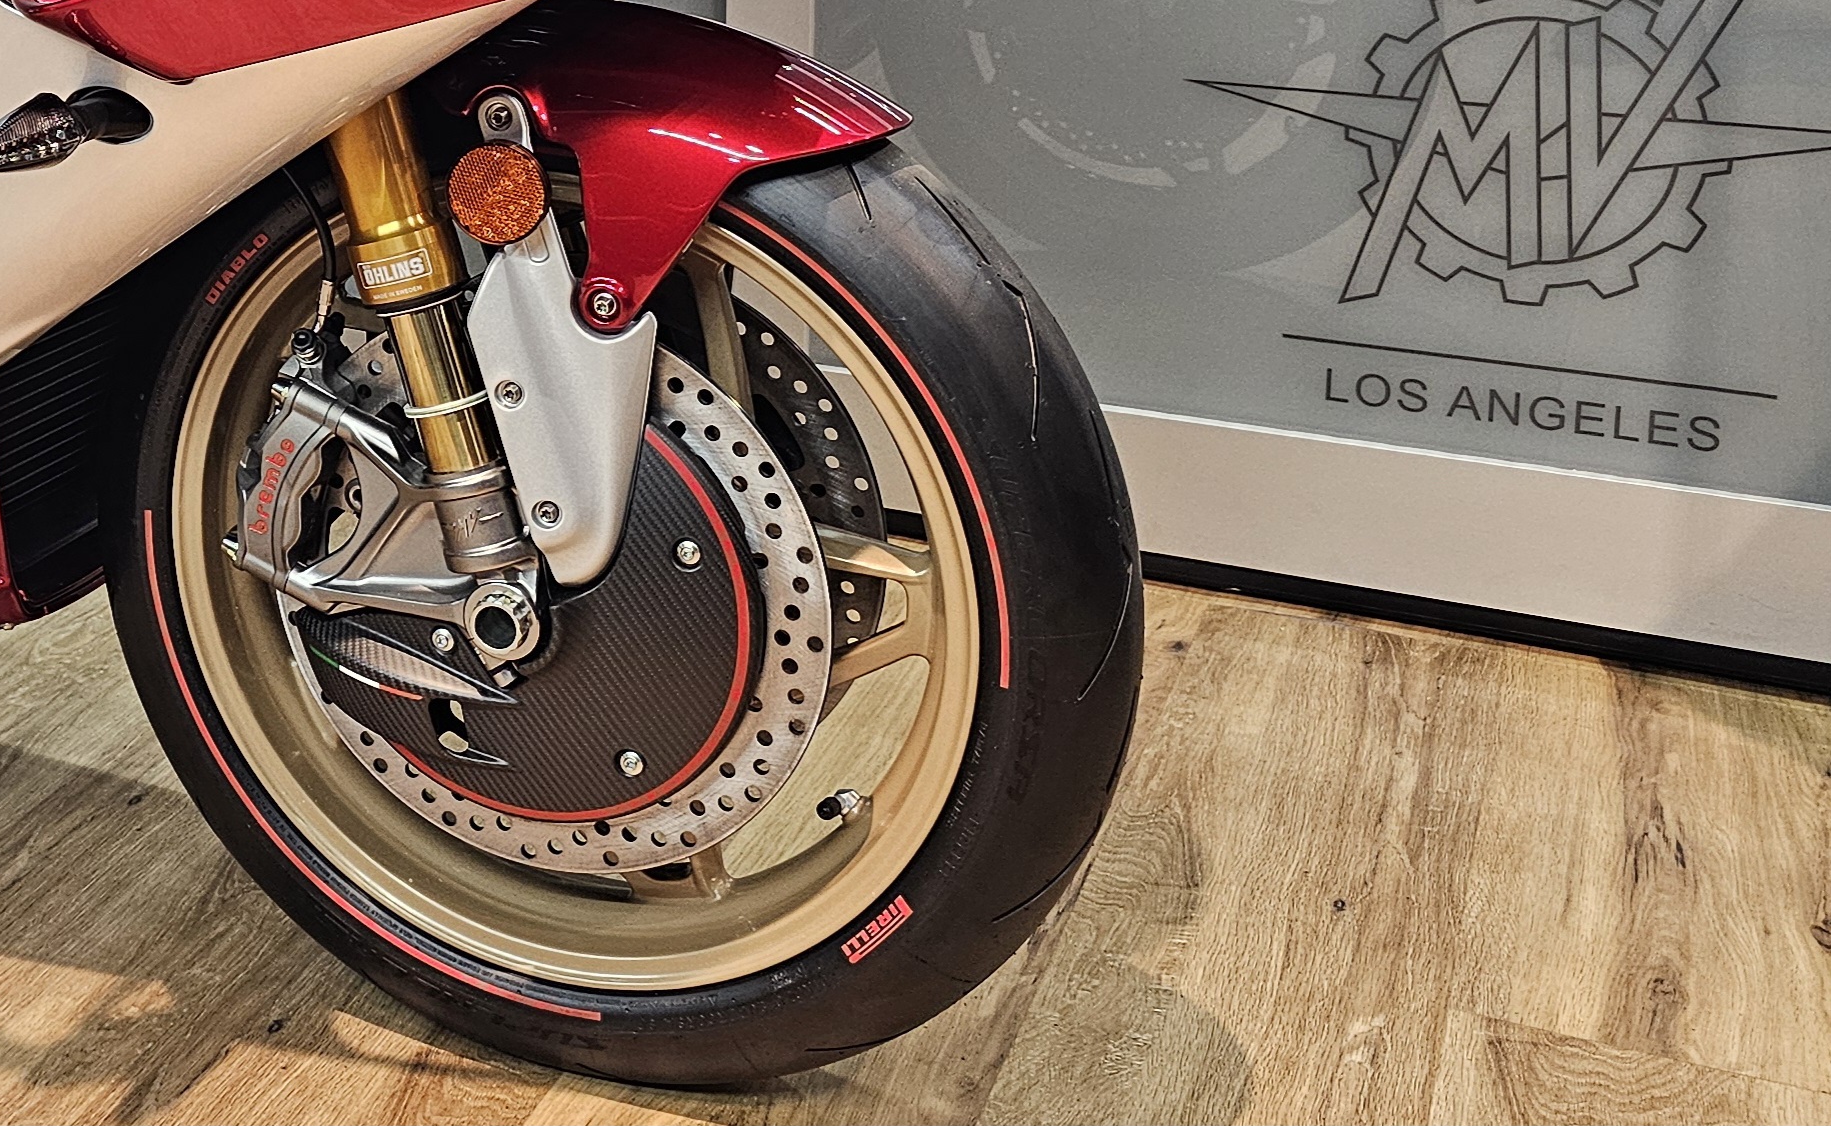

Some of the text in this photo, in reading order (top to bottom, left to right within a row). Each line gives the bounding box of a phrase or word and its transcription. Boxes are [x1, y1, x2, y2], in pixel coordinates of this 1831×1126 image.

[205, 233, 269, 305] DIABLO
[361, 256, 426, 286] ÖHLINS
[1324, 367, 1722, 453] LOS ANGELES
[247, 438, 295, 536] brembo
[840, 894, 914, 964] PIRELLI
